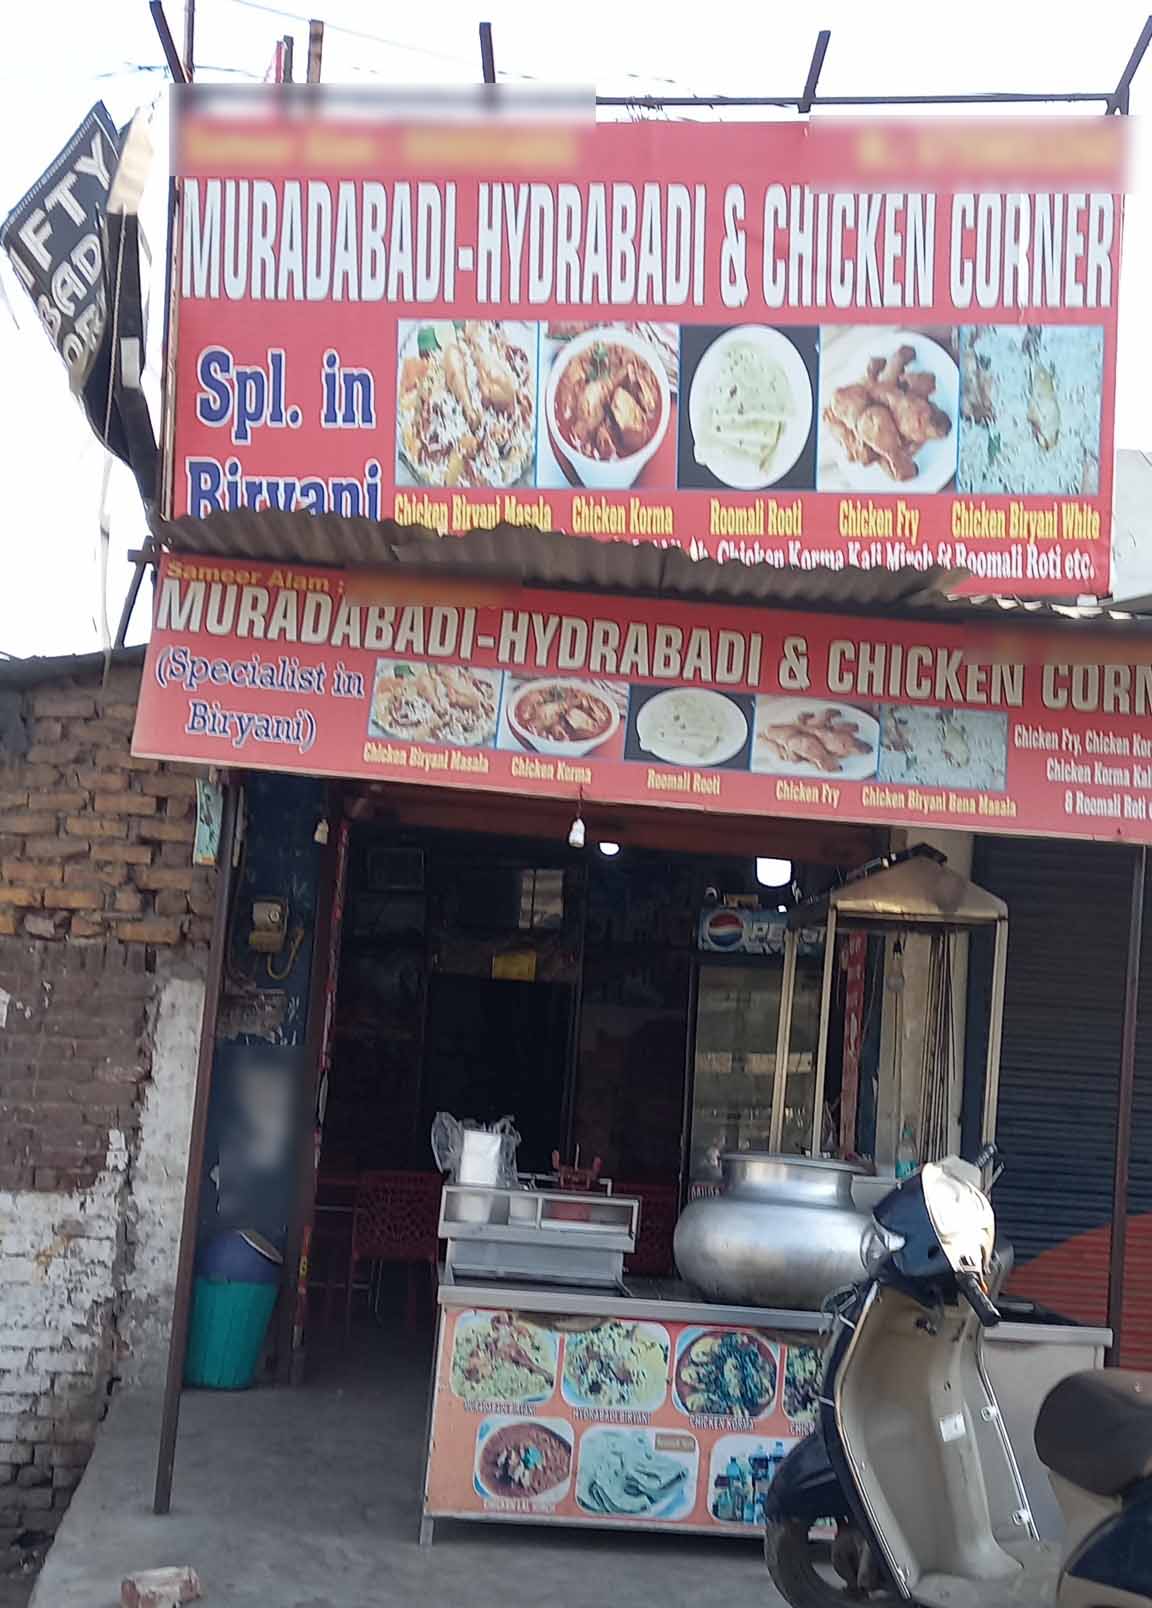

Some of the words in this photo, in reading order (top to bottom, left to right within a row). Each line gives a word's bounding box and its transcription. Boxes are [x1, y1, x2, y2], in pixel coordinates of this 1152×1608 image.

[181, 177, 707, 306] MURADABADI-HYDRABADI
[719, 183, 749, 308] &
[761, 183, 936, 309] CHICKEN
[948, 192, 1115, 310] CORNER
[197, 346, 302, 445] Spl.
[321, 349, 376, 429] in
[394, 493, 449, 532] Chicken
[504, 495, 552, 532] Masala
[572, 496, 625, 533] Chicken
[630, 497, 673, 534] Korma
[710, 497, 764, 536] Roomali
[768, 499, 803, 536] Rooti
[839, 499, 893, 537] Chicken
[896, 499, 920, 546] Fry
[951, 501, 1007, 538] Chicken
[1009, 501, 1057, 546] Biryani
[1061, 503, 1101, 540] White
[167, 559, 263, 584] Sameer
[267, 564, 330, 593] Alam
[788, 541, 844, 571] Korma
[847, 541, 882, 571] Kali
[954, 542, 1023, 579] Roomali
[1026, 544, 1062, 580] Roti
[1064, 549, 1096, 583] etc.
[156, 578, 763, 687] MURADABADI-HYDRABADI
[779, 636, 811, 690] &
[826, 639, 1024, 708] CHICKEN
[155, 645, 326, 697] (Specialist
[331, 661, 365, 697] in
[184, 699, 316, 754] Biryani)
[1014, 723, 1058, 750] Chicken
[1062, 727, 1082, 757] Fry,
[1085, 728, 1130, 756] Chicken
[363, 741, 406, 766] Chicken
[409, 746, 448, 772] Biryani
[450, 749, 489, 773] Masala
[511, 755, 554, 780] Chicken
[557, 760, 592, 785] Korma
[1047, 757, 1091, 784] Chicken
[1094, 761, 1130, 786] Korma
[647, 768, 690, 791] Roomali
[776, 779, 819, 802] Chicken
[821, 783, 840, 809] Fry
[862, 785, 905, 808] Chicken
[908, 789, 946, 815] Biryani
[978, 794, 1017, 817] Masala
[1076, 791, 1121, 817] Roomali
[1124, 795, 1147, 819] Roti
